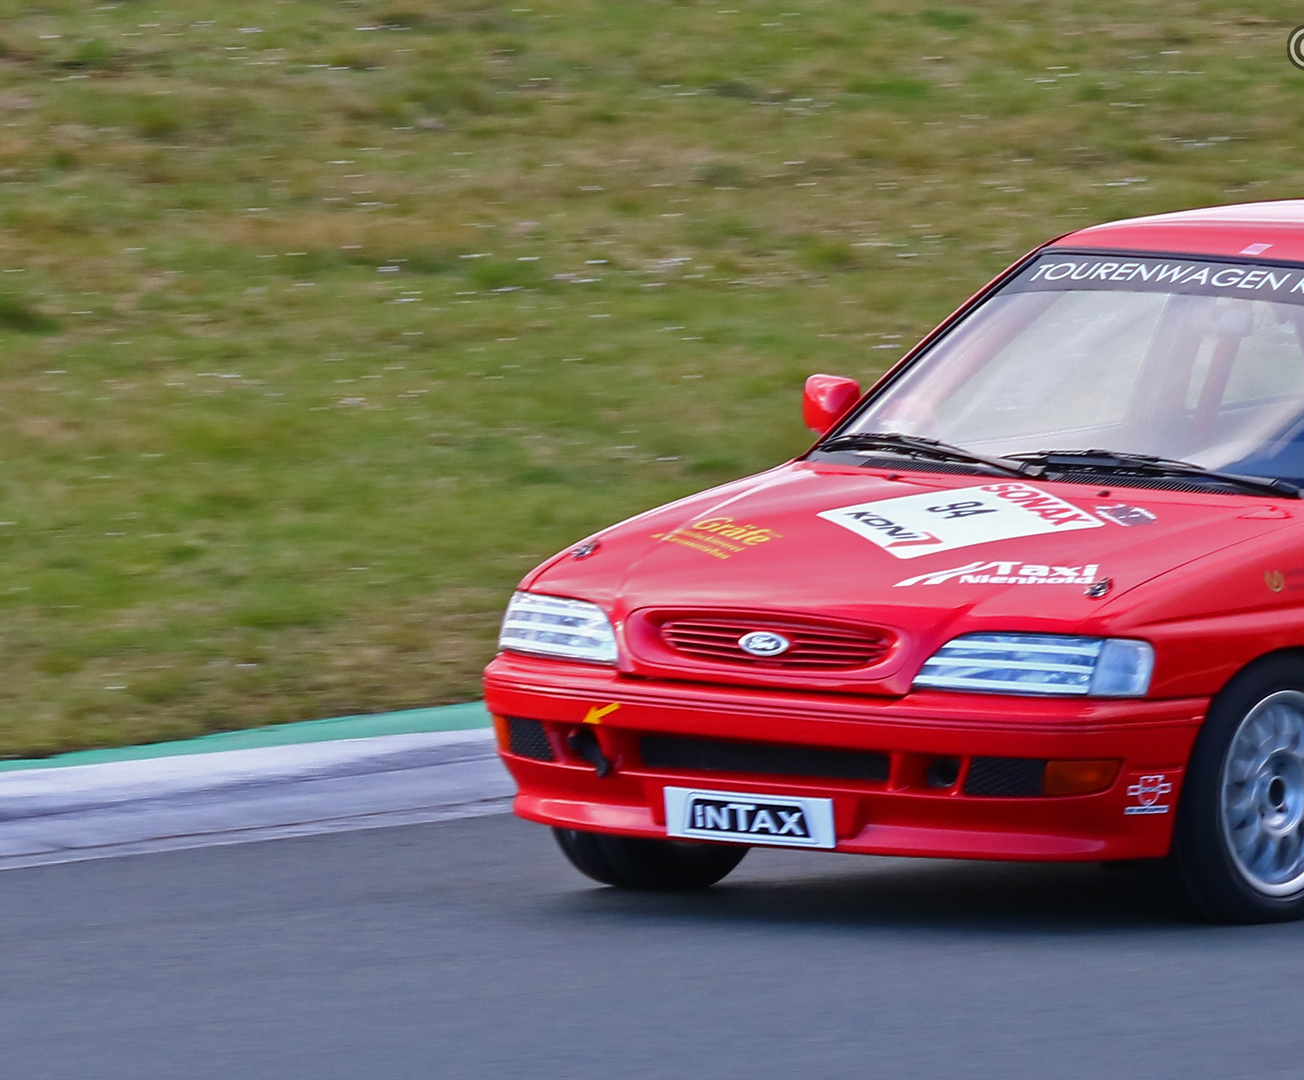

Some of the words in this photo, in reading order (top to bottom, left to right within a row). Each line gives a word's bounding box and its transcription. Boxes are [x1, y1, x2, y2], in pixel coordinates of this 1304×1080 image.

[1029, 260, 1291, 291] TOURENWAGEN
[926, 501, 998, 520] 94
[980, 484, 1092, 526] SONAX
[692, 517, 772, 546] Gräfe
[846, 511, 922, 540] KONI
[958, 573, 1095, 585] Nienhold
[990, 561, 1099, 577] Taxi
